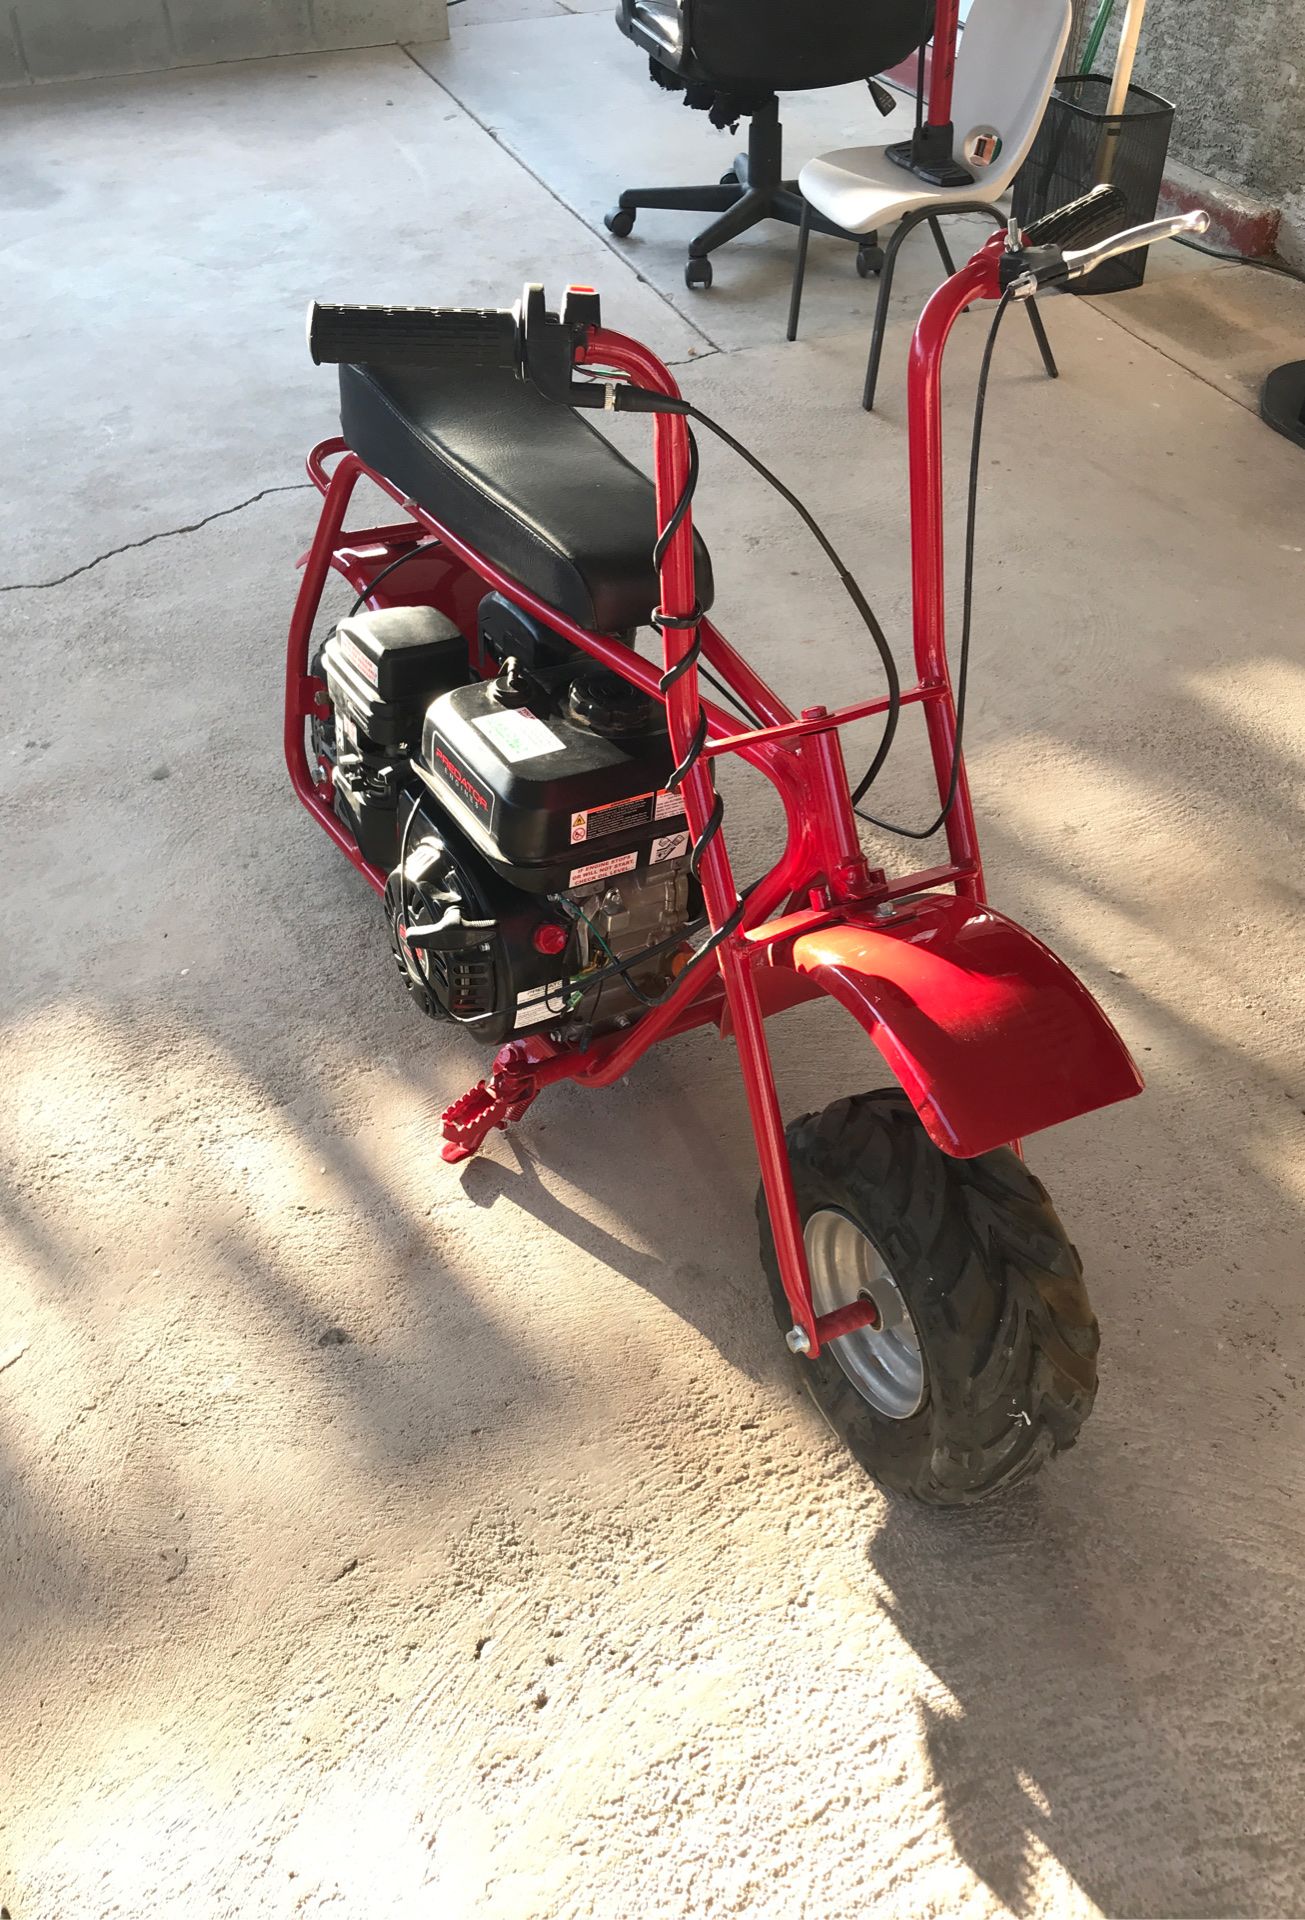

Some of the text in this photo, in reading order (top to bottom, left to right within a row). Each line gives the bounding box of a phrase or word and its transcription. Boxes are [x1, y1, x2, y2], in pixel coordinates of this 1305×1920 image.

[436, 747, 488, 812] PREDATOR
[444, 767, 478, 809] ENGINES
[585, 861, 610, 871] ENGINE
[611, 855, 631, 864] STOPS
[574, 877, 596, 886] CHECK
